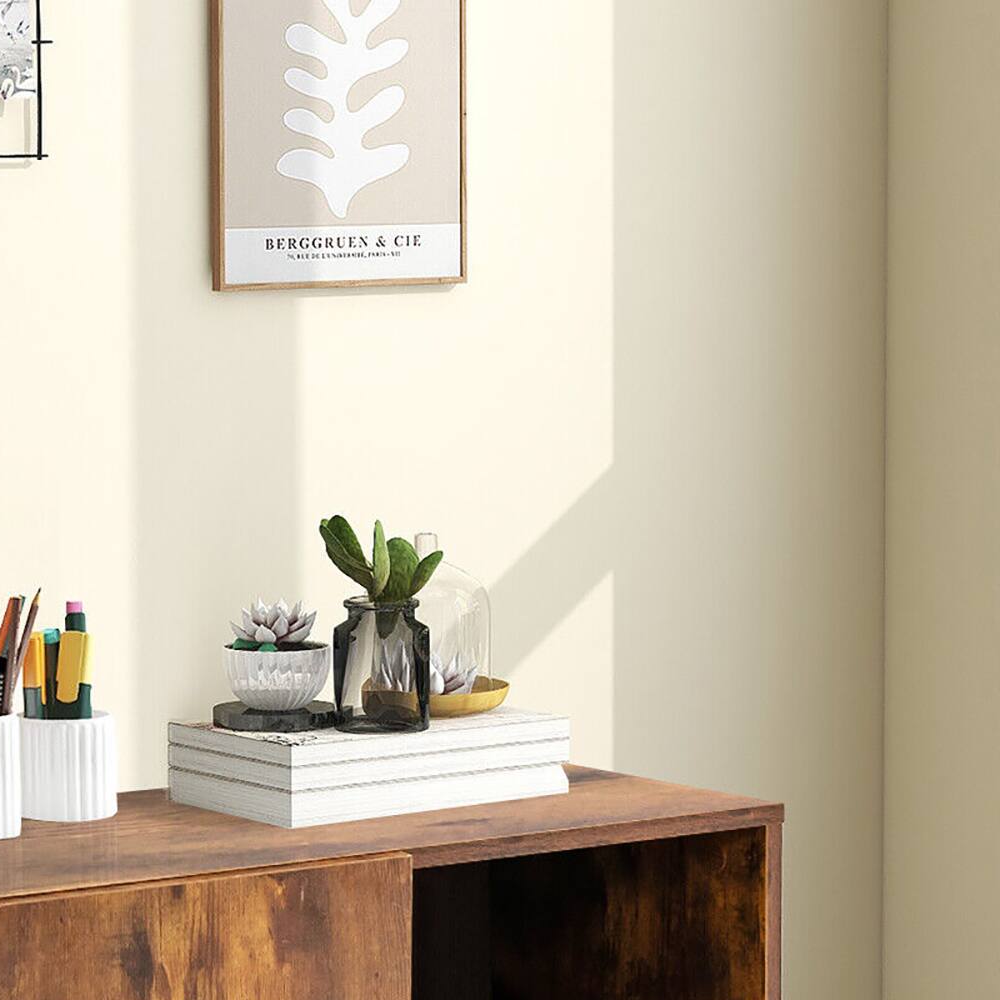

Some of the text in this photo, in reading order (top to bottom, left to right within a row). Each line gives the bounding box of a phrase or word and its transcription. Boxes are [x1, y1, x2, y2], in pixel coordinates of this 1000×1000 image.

[265, 234, 422, 251] BERGGRUEN & CIE
